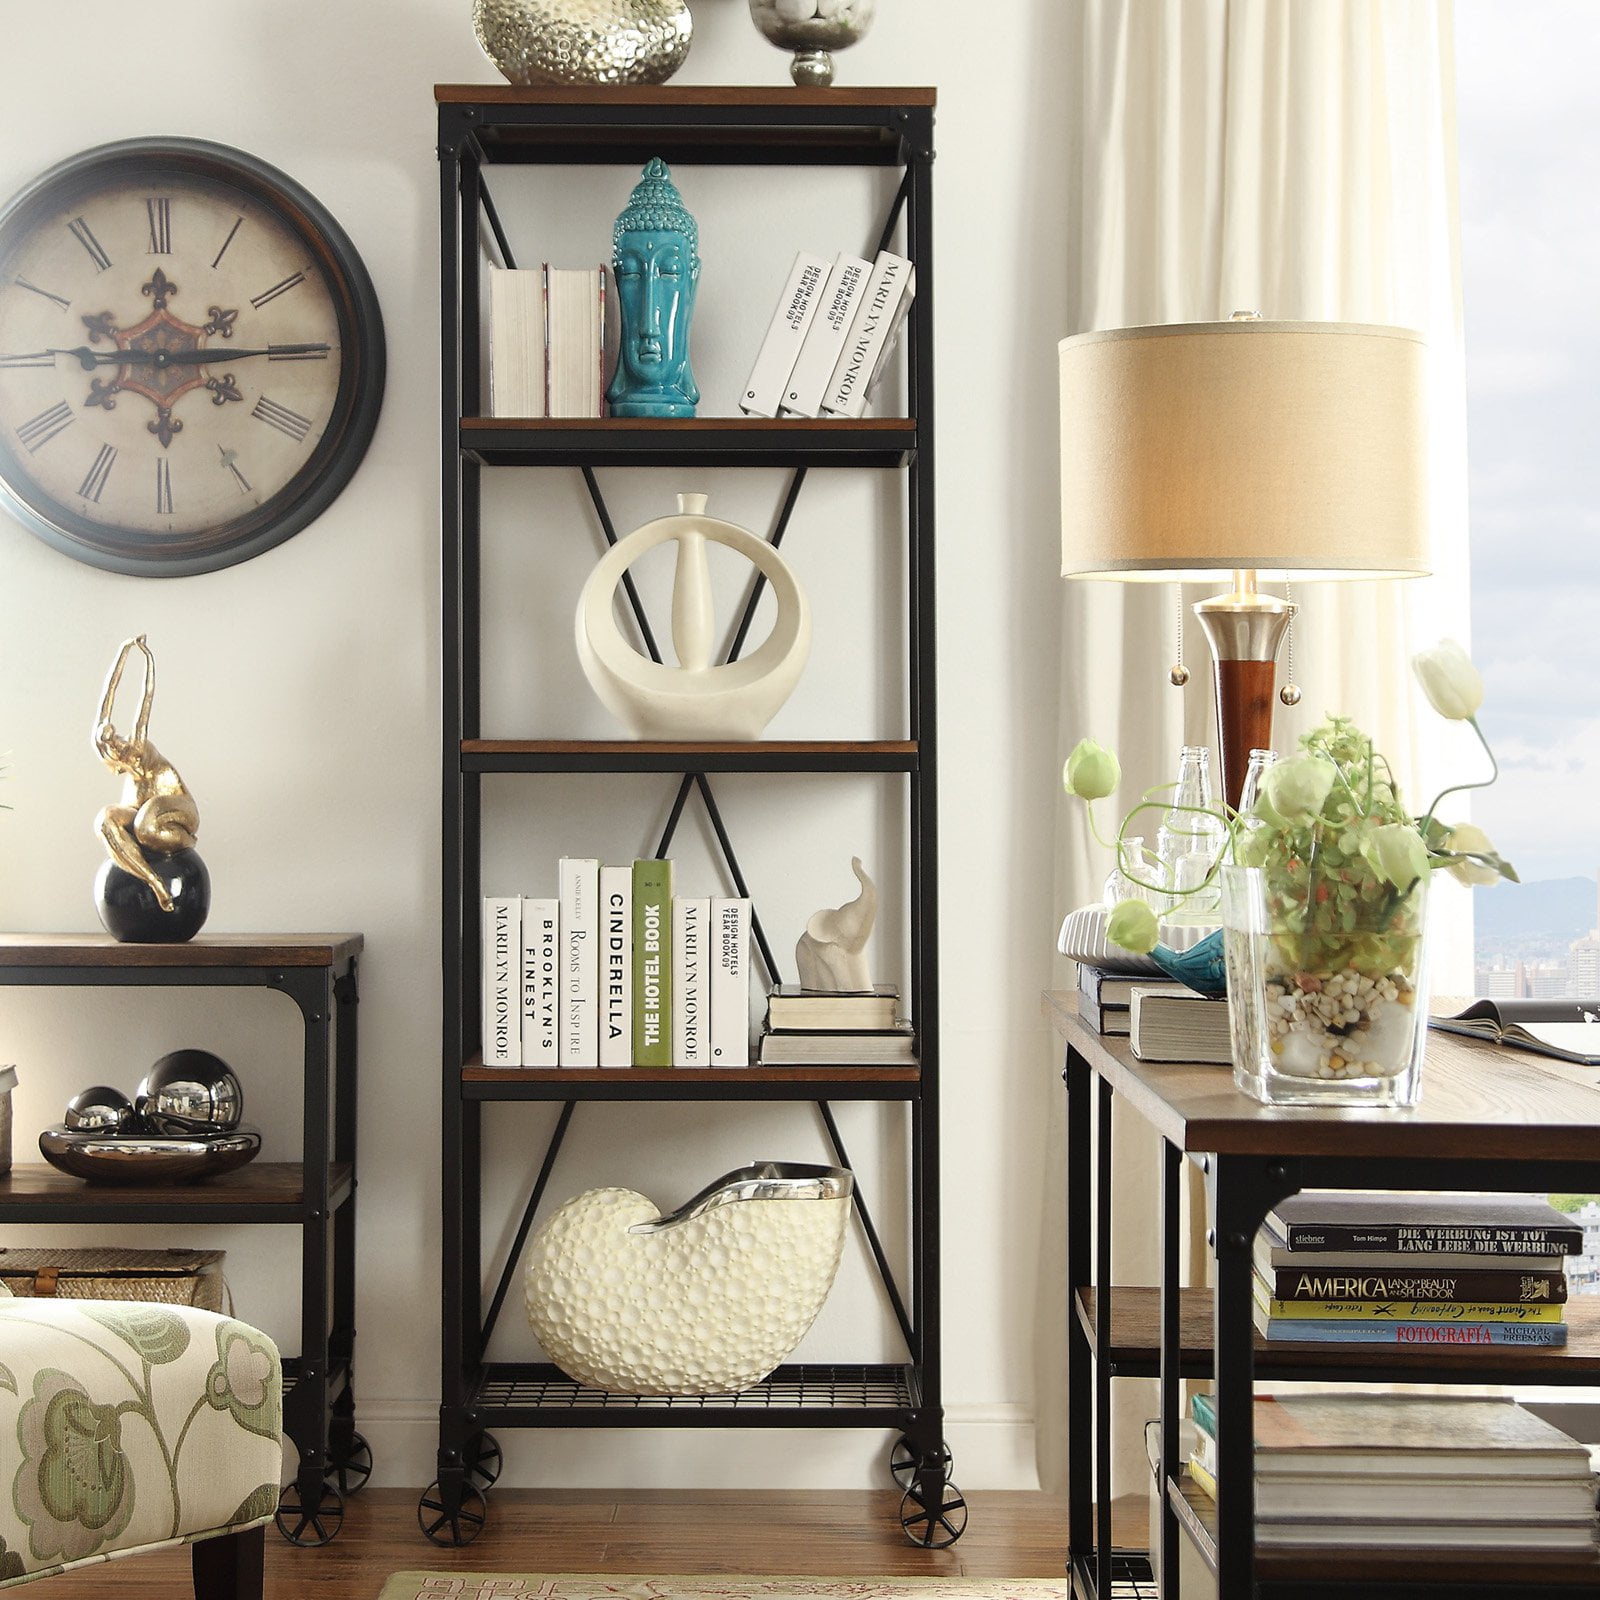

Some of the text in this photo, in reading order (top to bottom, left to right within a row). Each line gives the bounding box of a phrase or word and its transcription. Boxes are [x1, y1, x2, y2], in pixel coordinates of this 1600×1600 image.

[799, 265, 815, 286] YEAR
[840, 265, 856, 286] YEAR
[791, 267, 822, 331] DESIGN HOTELS
[832, 267, 862, 331] DESIGN HOTELS
[835, 262, 899, 406] MARILYN MONROE
[574, 874, 582, 921] ANNIE KELLY
[645, 904, 660, 951] BOOK
[722, 907, 731, 931] YEAR
[730, 907, 739, 976] DESIGN HOTELS
[496, 906, 509, 1059] MARILYN MONROE
[609, 893, 624, 1040] CINDERELLA
[645, 955, 660, 1009] HOTEL
[525, 948, 536, 1020] FINEST
[542, 920, 553, 1049] BROOKLYN'S
[685, 906, 698, 1060] MARILYN MONROE
[645, 1014, 660, 1046] THE
[1397, 1228, 1548, 1242] DIE WERBUNG IST TOT
[1397, 1240, 1568, 1254] LANG LEBE DIE WERBUNG
[1294, 1272, 1389, 1298] AMERICA
[1388, 1278, 1414, 1289] LAND
[1421, 1278, 1457, 1289] BEAUTY
[1401, 1288, 1454, 1299] SPLENDOR
[1495, 1304, 1527, 1318] Giant
[1396, 1324, 1493, 1344] FOTOGRAFÍA
[1503, 1326, 1550, 1335] MICHAEL
[1503, 1334, 1552, 1343] FREEMAN
